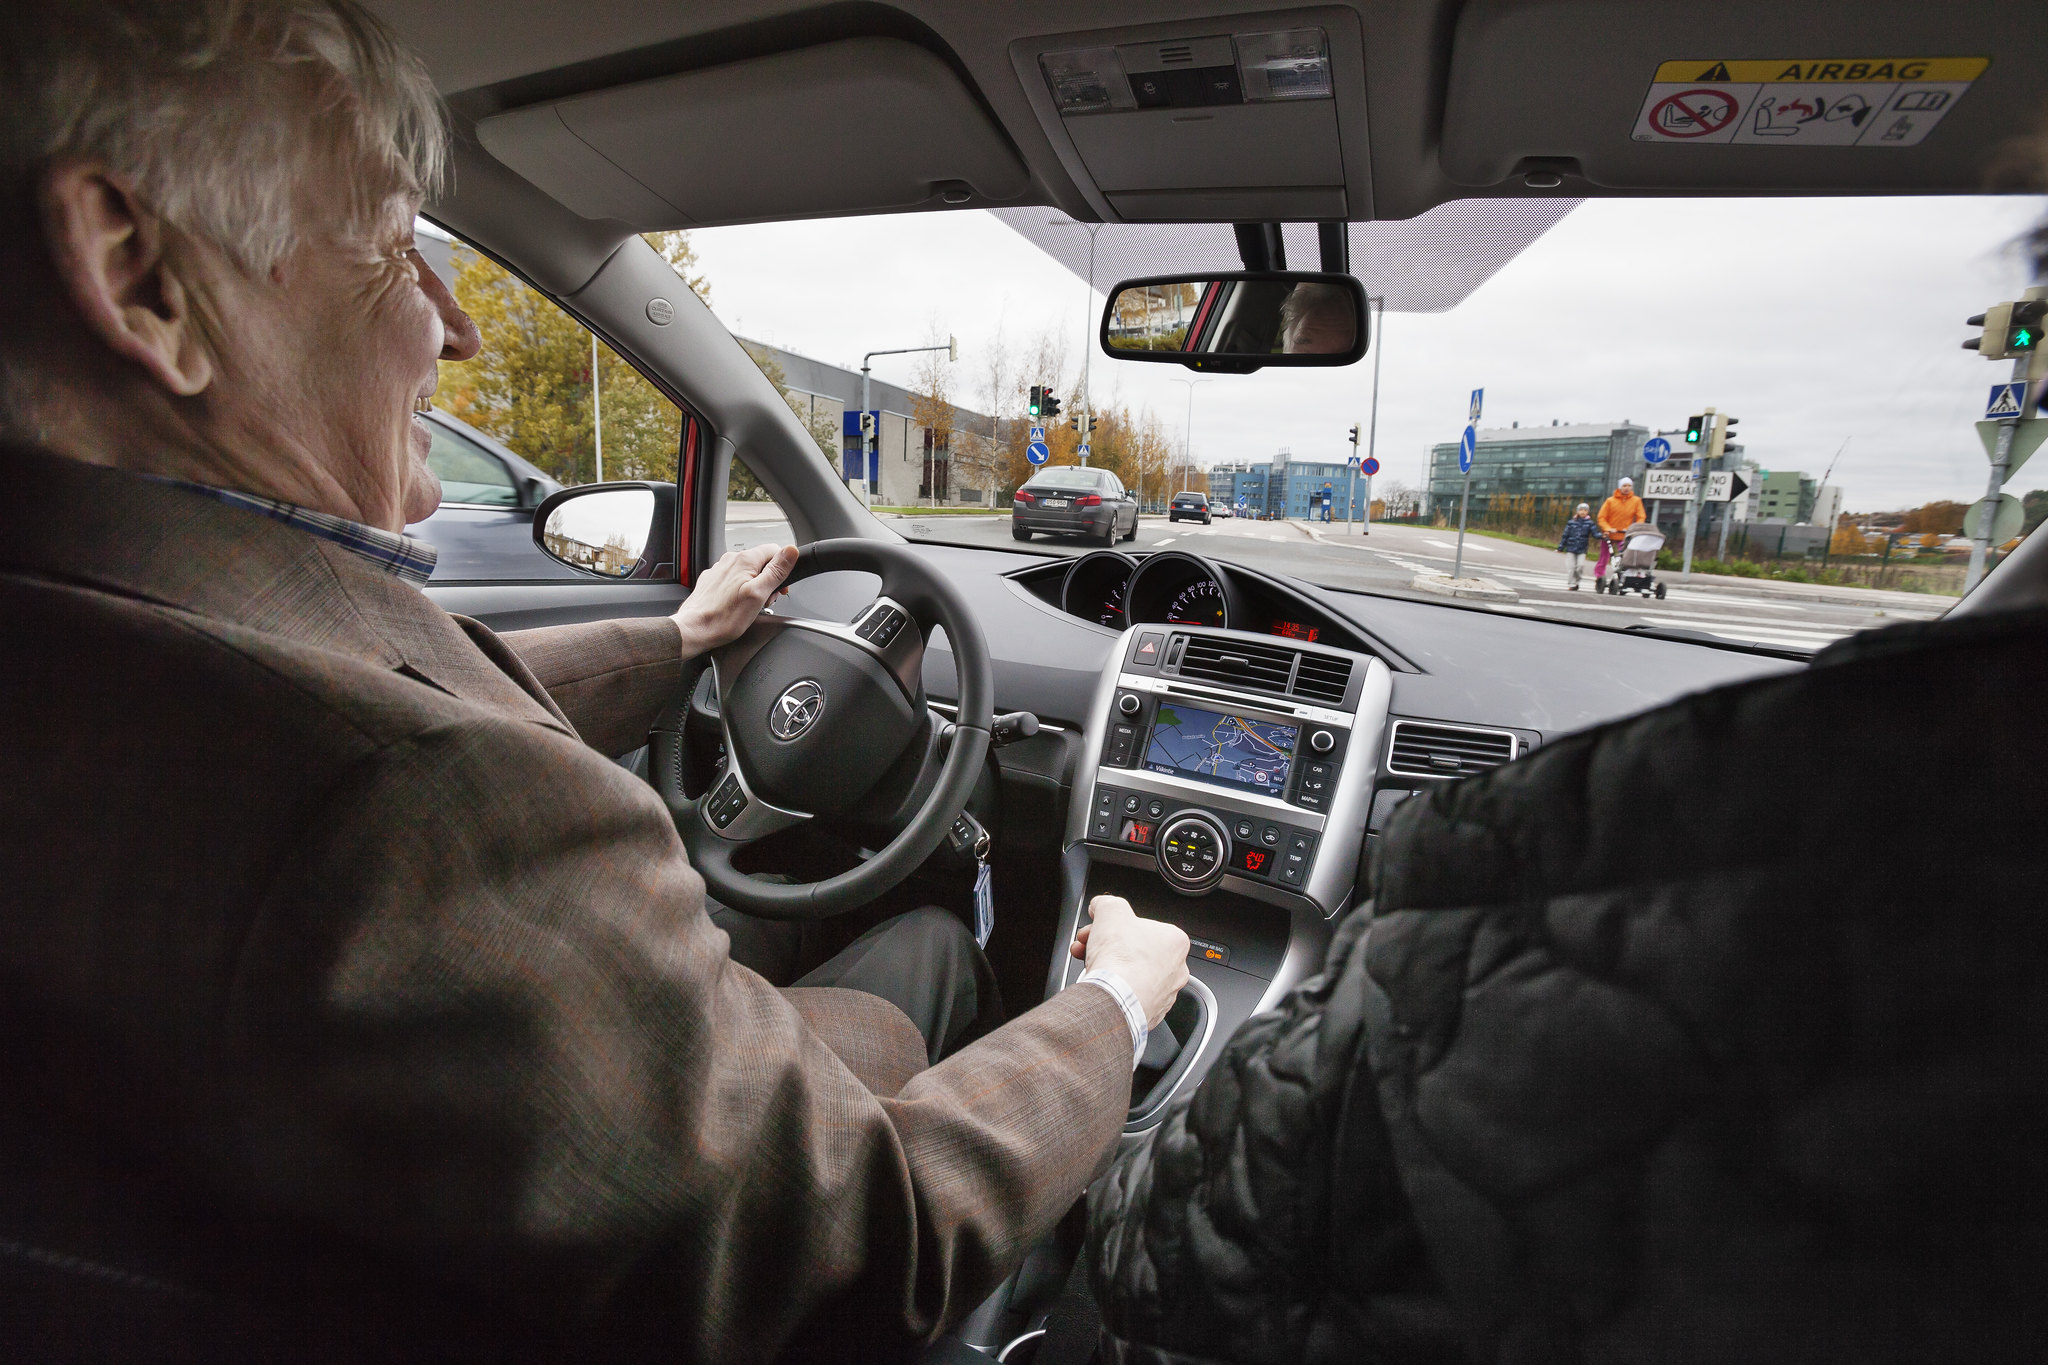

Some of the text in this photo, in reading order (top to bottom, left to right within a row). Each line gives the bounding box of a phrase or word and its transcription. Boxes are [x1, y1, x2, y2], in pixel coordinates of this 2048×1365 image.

[1777, 62, 1930, 80] AIRBAG
[1650, 474, 1727, 484] LATOKANO
[1648, 485, 1722, 497] LADUGÅREN
[1167, 845, 1178, 853] AUTO
[1203, 853, 1214, 862] DUAL
[1289, 854, 1302, 862] TEMP
